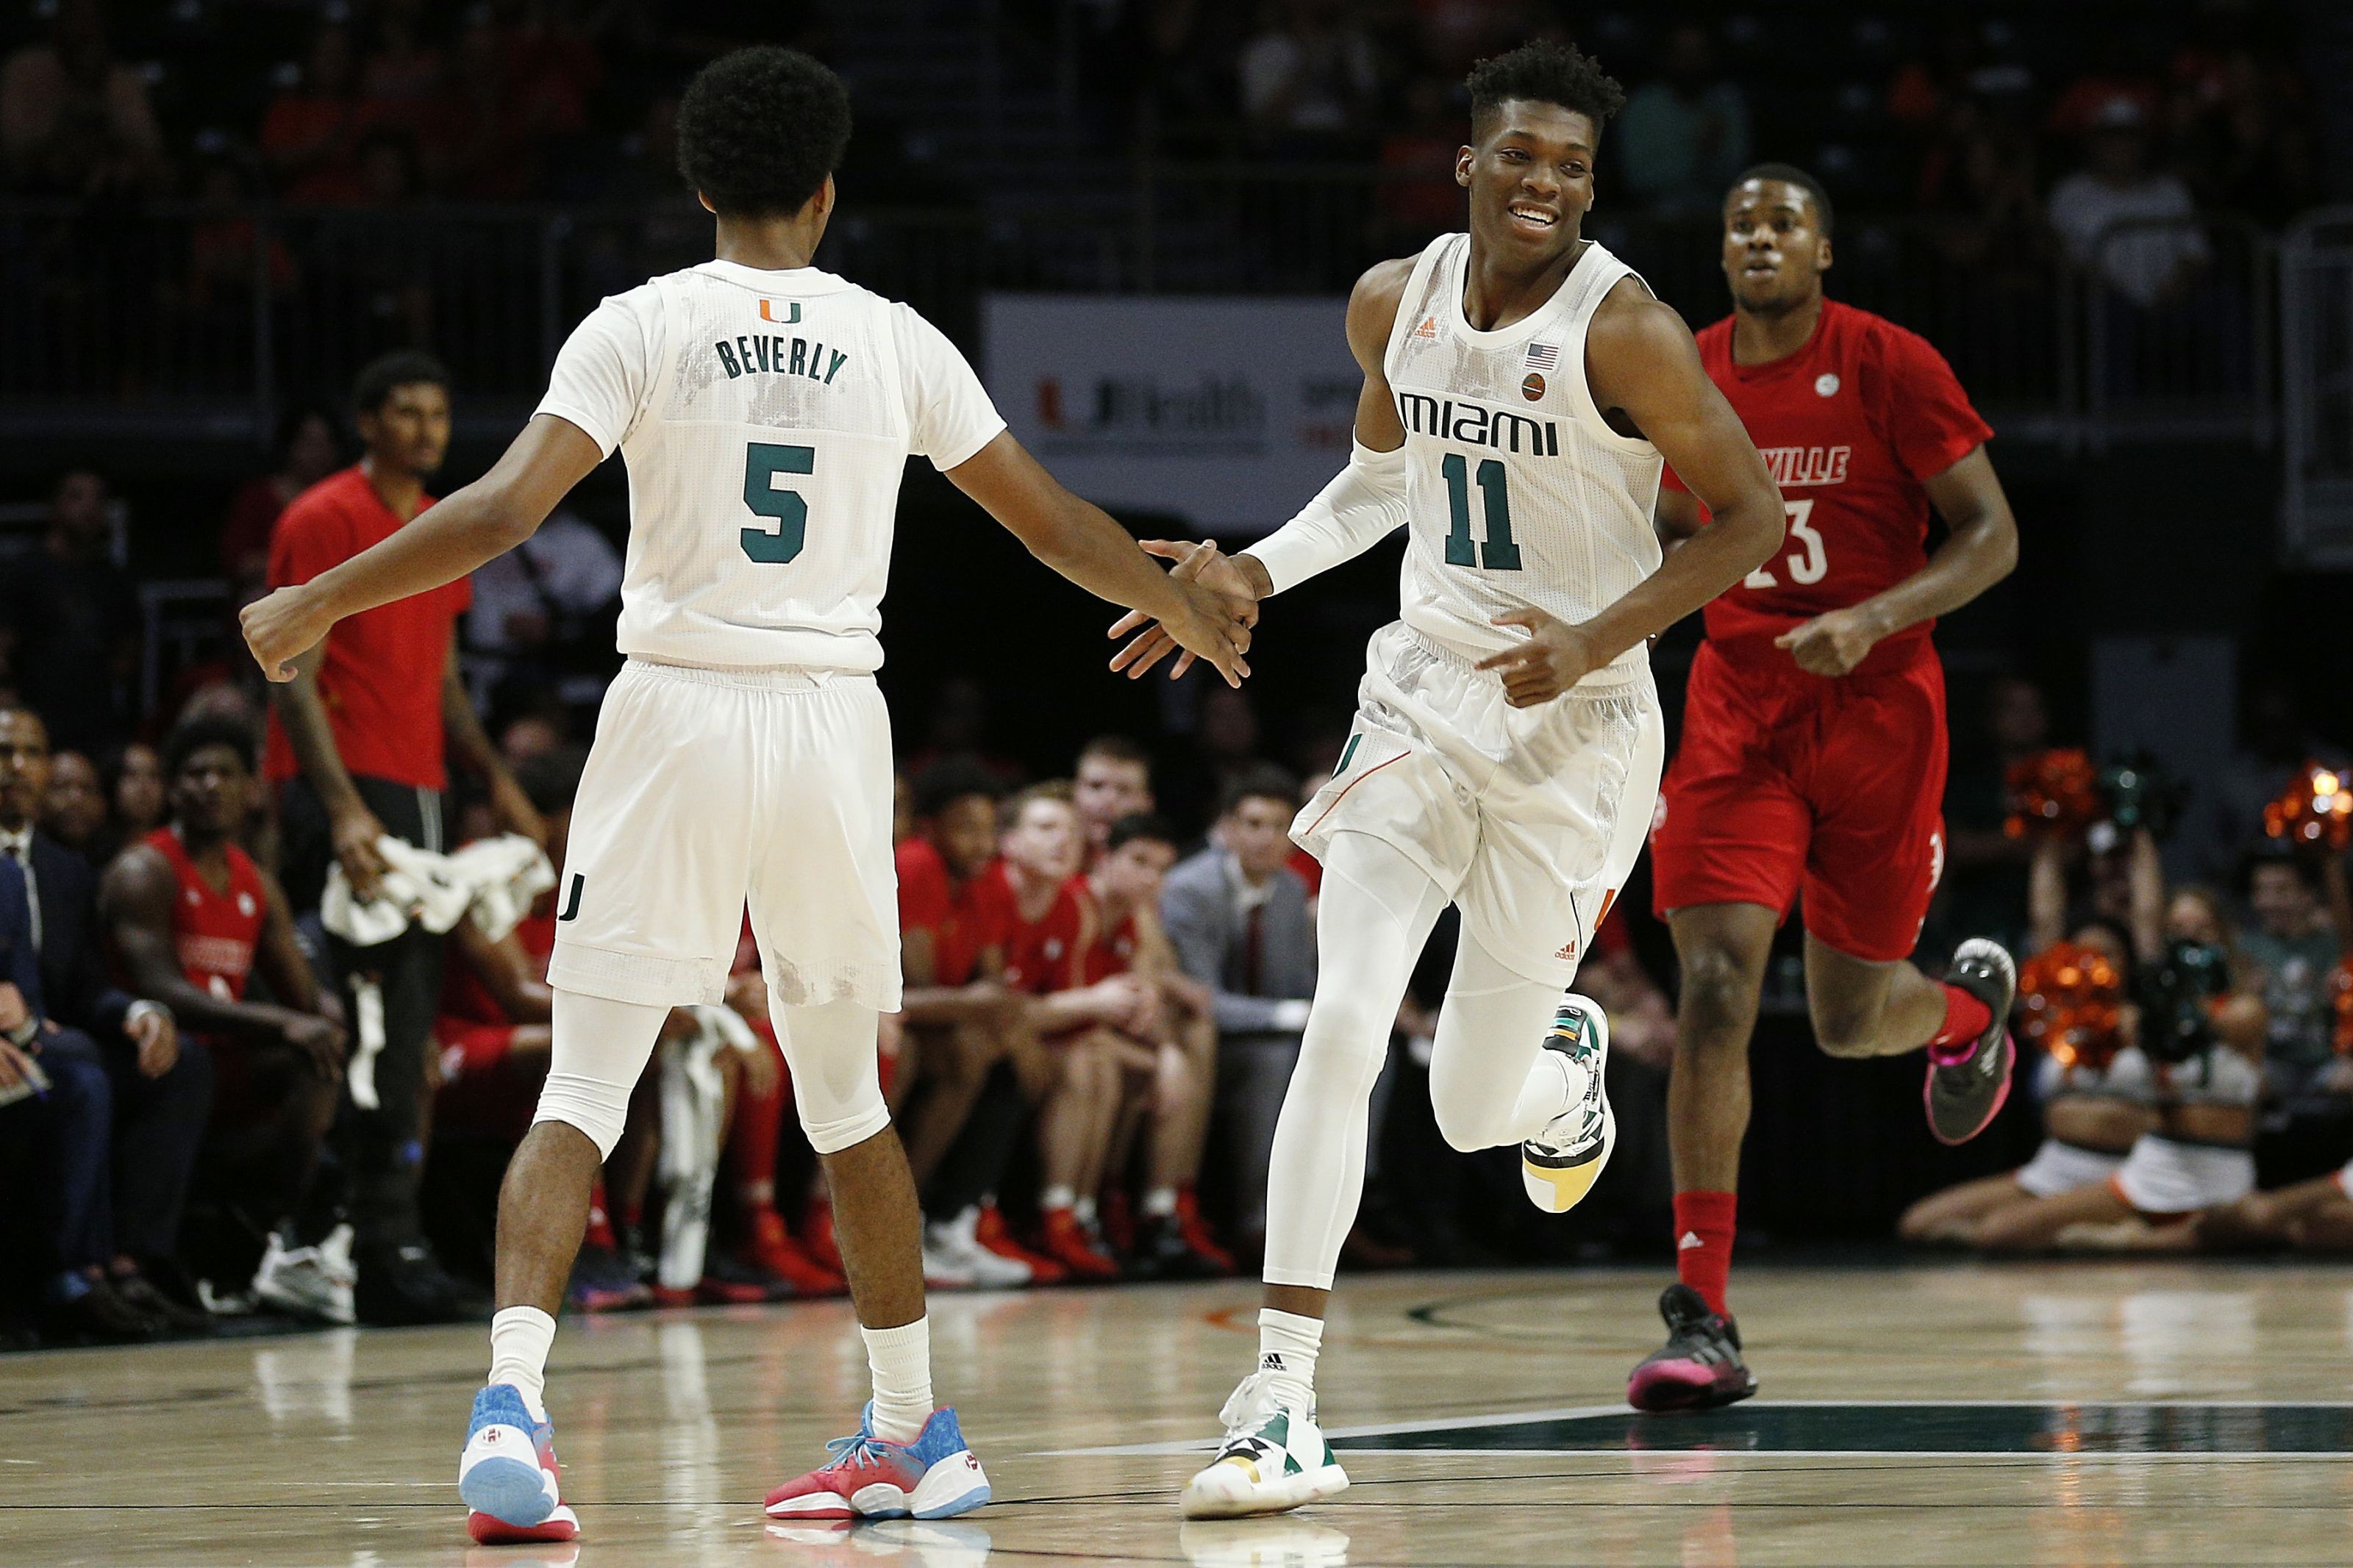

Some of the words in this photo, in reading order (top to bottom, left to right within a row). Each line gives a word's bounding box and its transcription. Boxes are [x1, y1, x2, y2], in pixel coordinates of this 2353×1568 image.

[759, 299, 801, 324] U
[715, 335, 848, 384] BEVERLY
[740, 442, 815, 563] 5
[1442, 453, 1522, 571] 11
